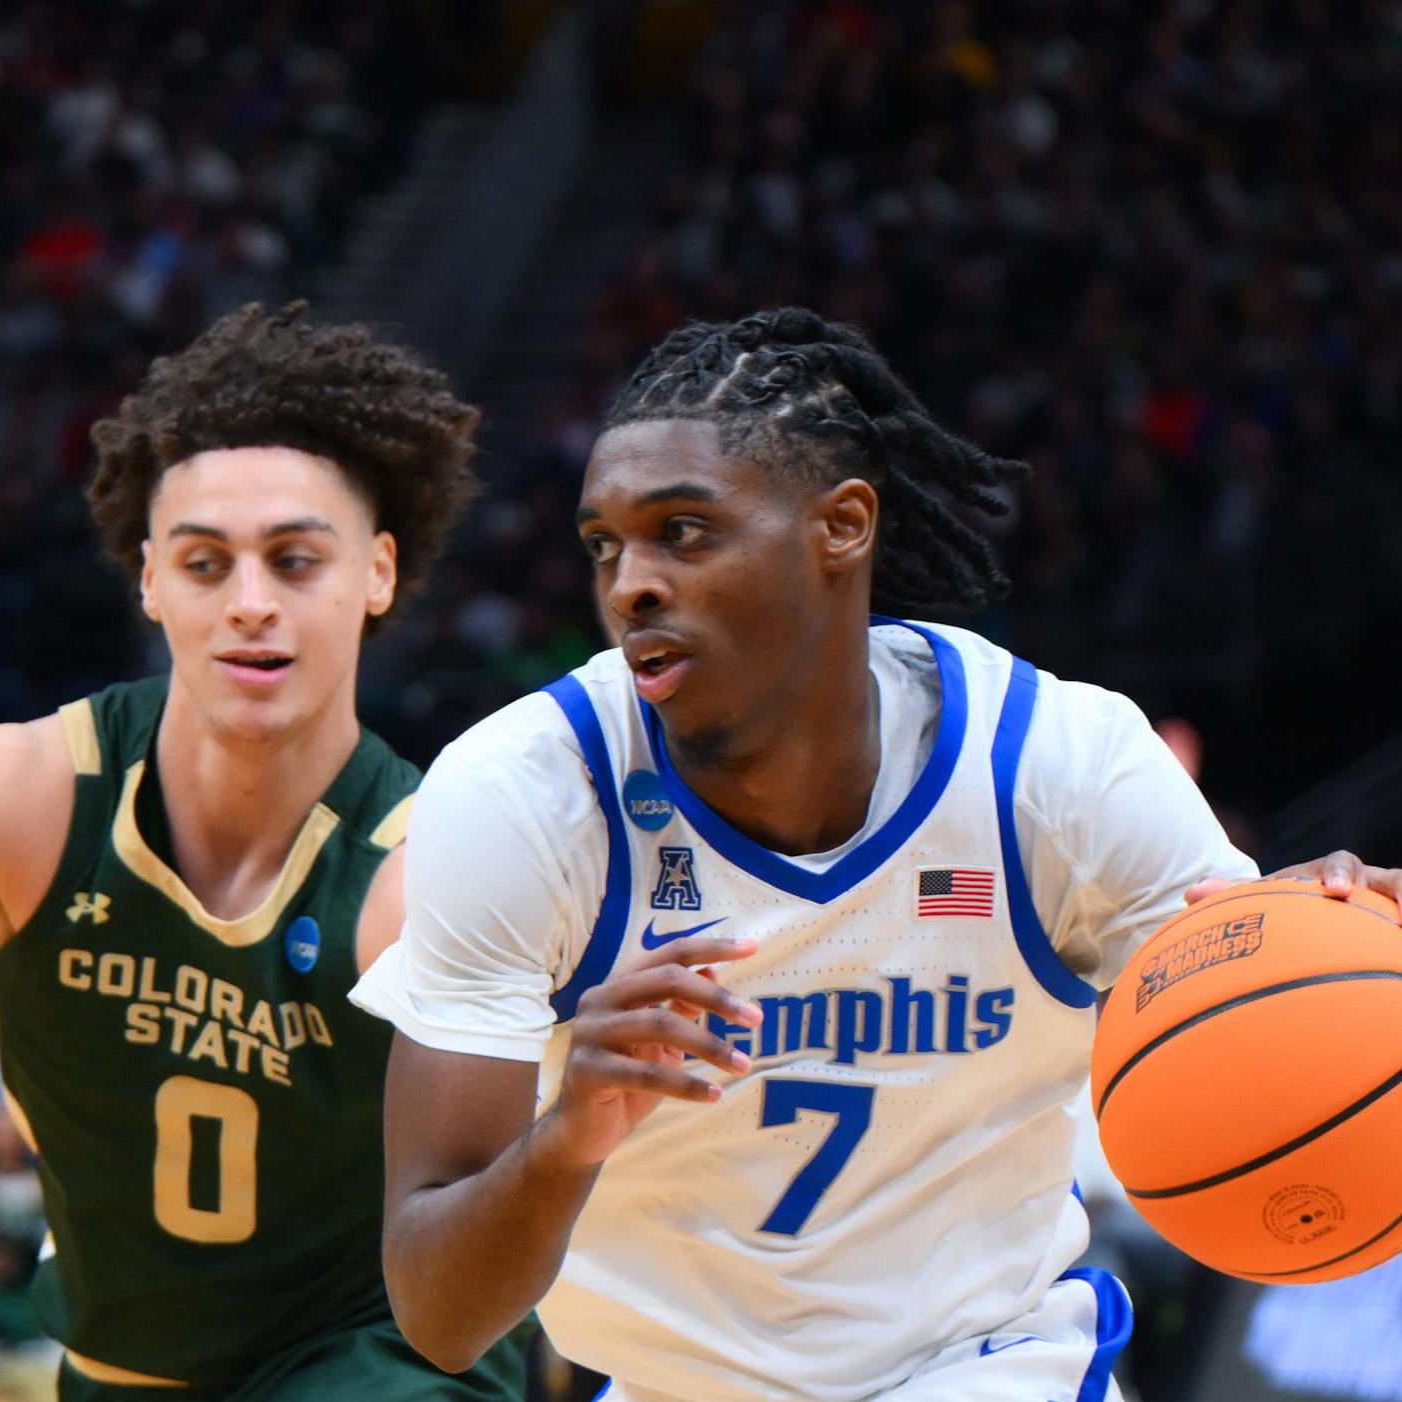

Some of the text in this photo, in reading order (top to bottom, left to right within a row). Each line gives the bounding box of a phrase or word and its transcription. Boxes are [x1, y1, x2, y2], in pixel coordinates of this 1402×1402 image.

[631, 799, 673, 815] NCAA
[59, 948, 334, 1051] COLORADO
[1164, 930, 1263, 982] MADNESS
[125, 1003, 292, 1086] STATE
[684, 974, 1015, 1066] emphis
[154, 1075, 259, 1244] 0
[756, 1077, 877, 1238] 7
